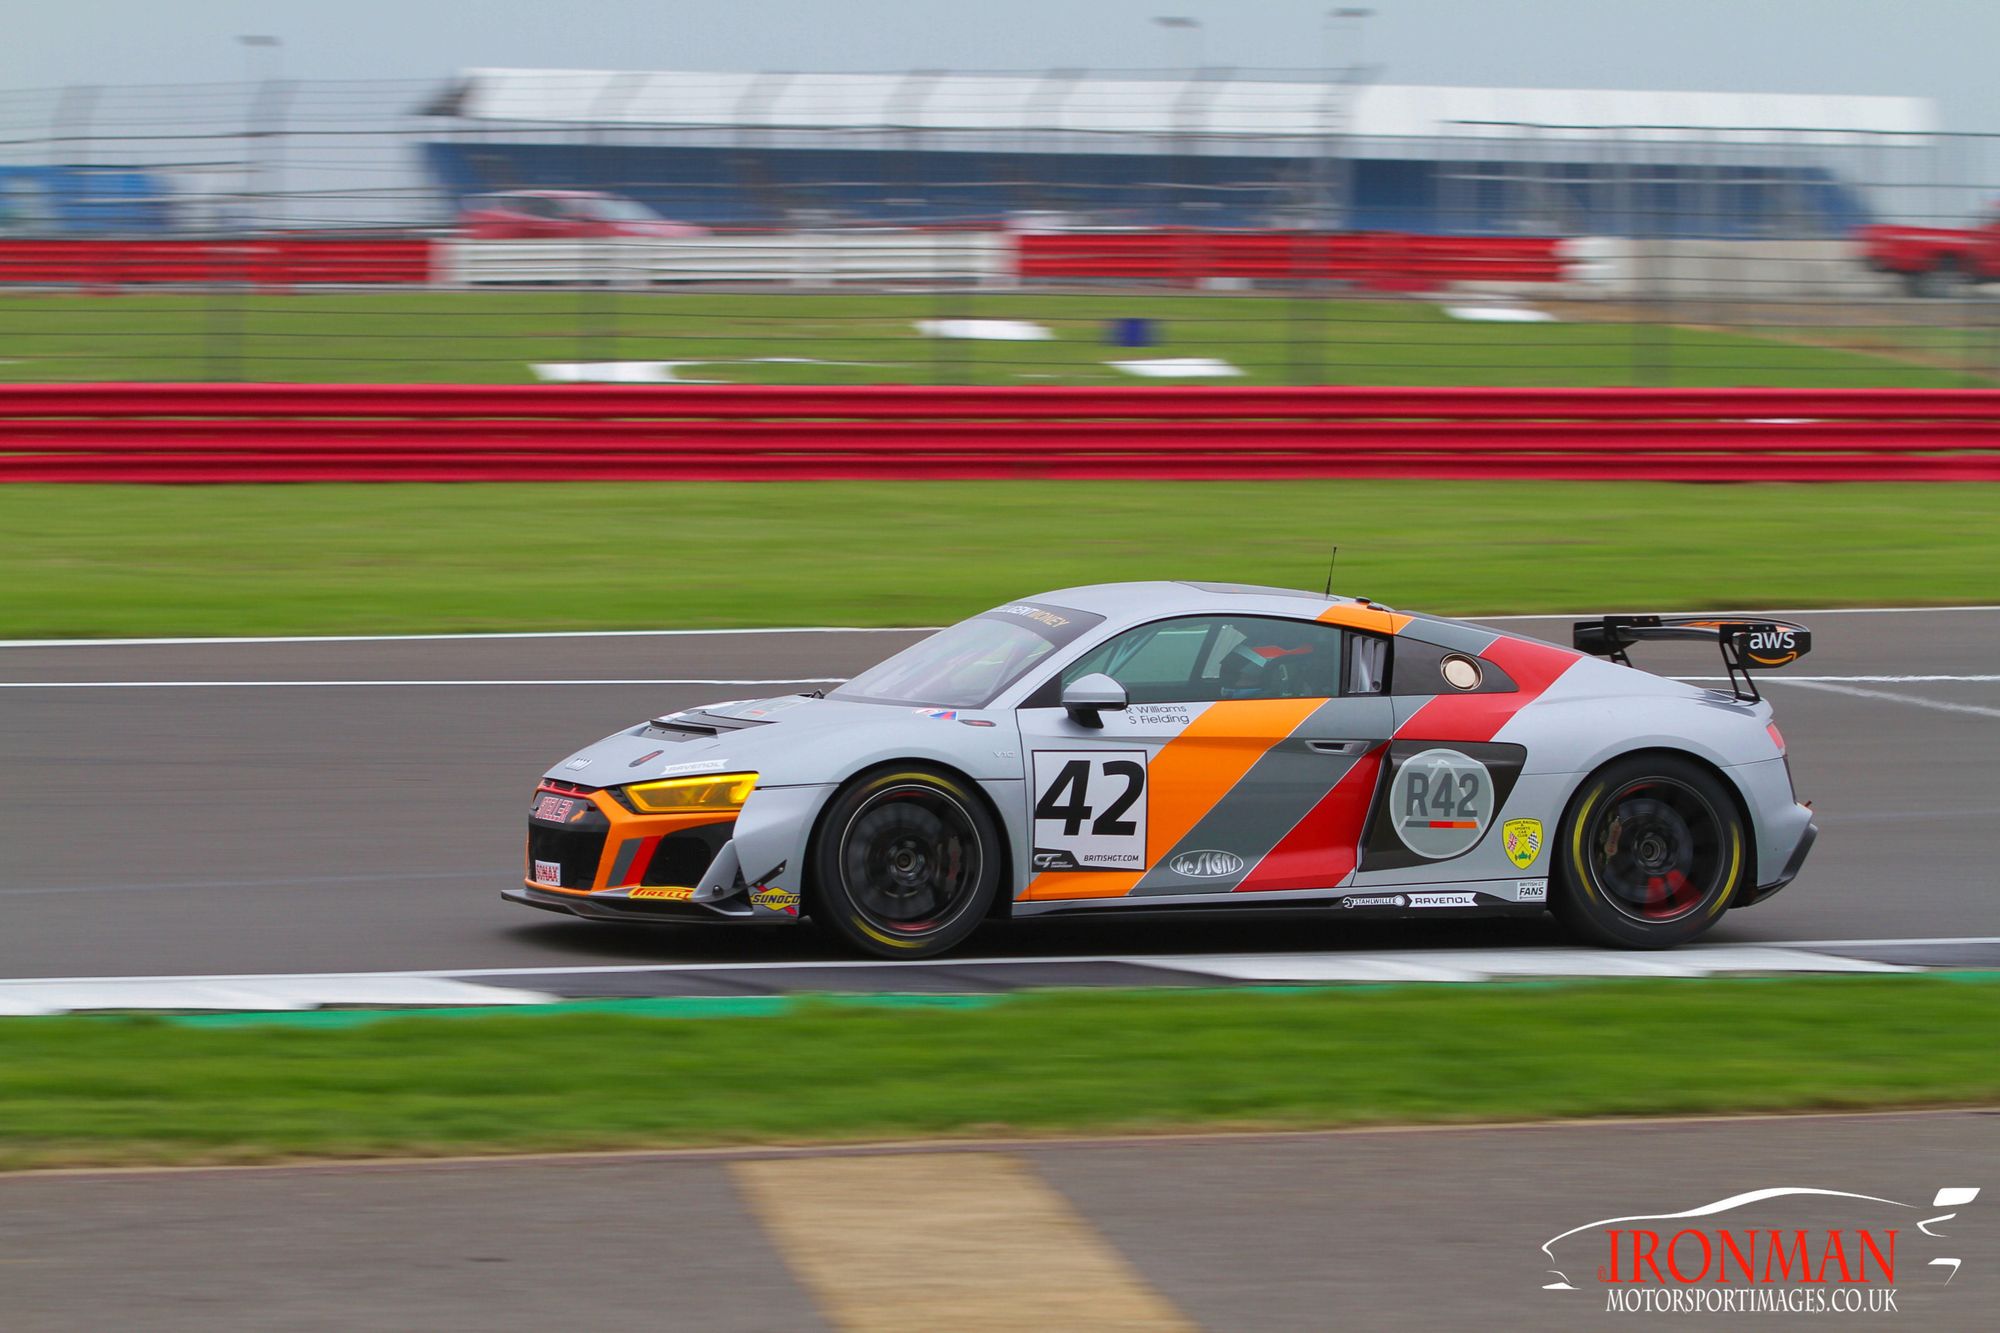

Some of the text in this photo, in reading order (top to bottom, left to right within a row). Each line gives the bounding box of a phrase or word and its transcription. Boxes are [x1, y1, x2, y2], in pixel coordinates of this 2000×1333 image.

[1750, 631, 1796, 650] aws
[1136, 705, 1187, 713] Williams
[1128, 714, 1190, 725] S Fielding
[1035, 760, 1145, 836] 42
[1406, 772, 1479, 818] R42
[1083, 854, 1139, 862] BRITISHGT.COM
[1519, 887, 1544, 895] FANS
[752, 894, 800, 904] SUNOCO
[1415, 896, 1470, 904] RAVENOL
